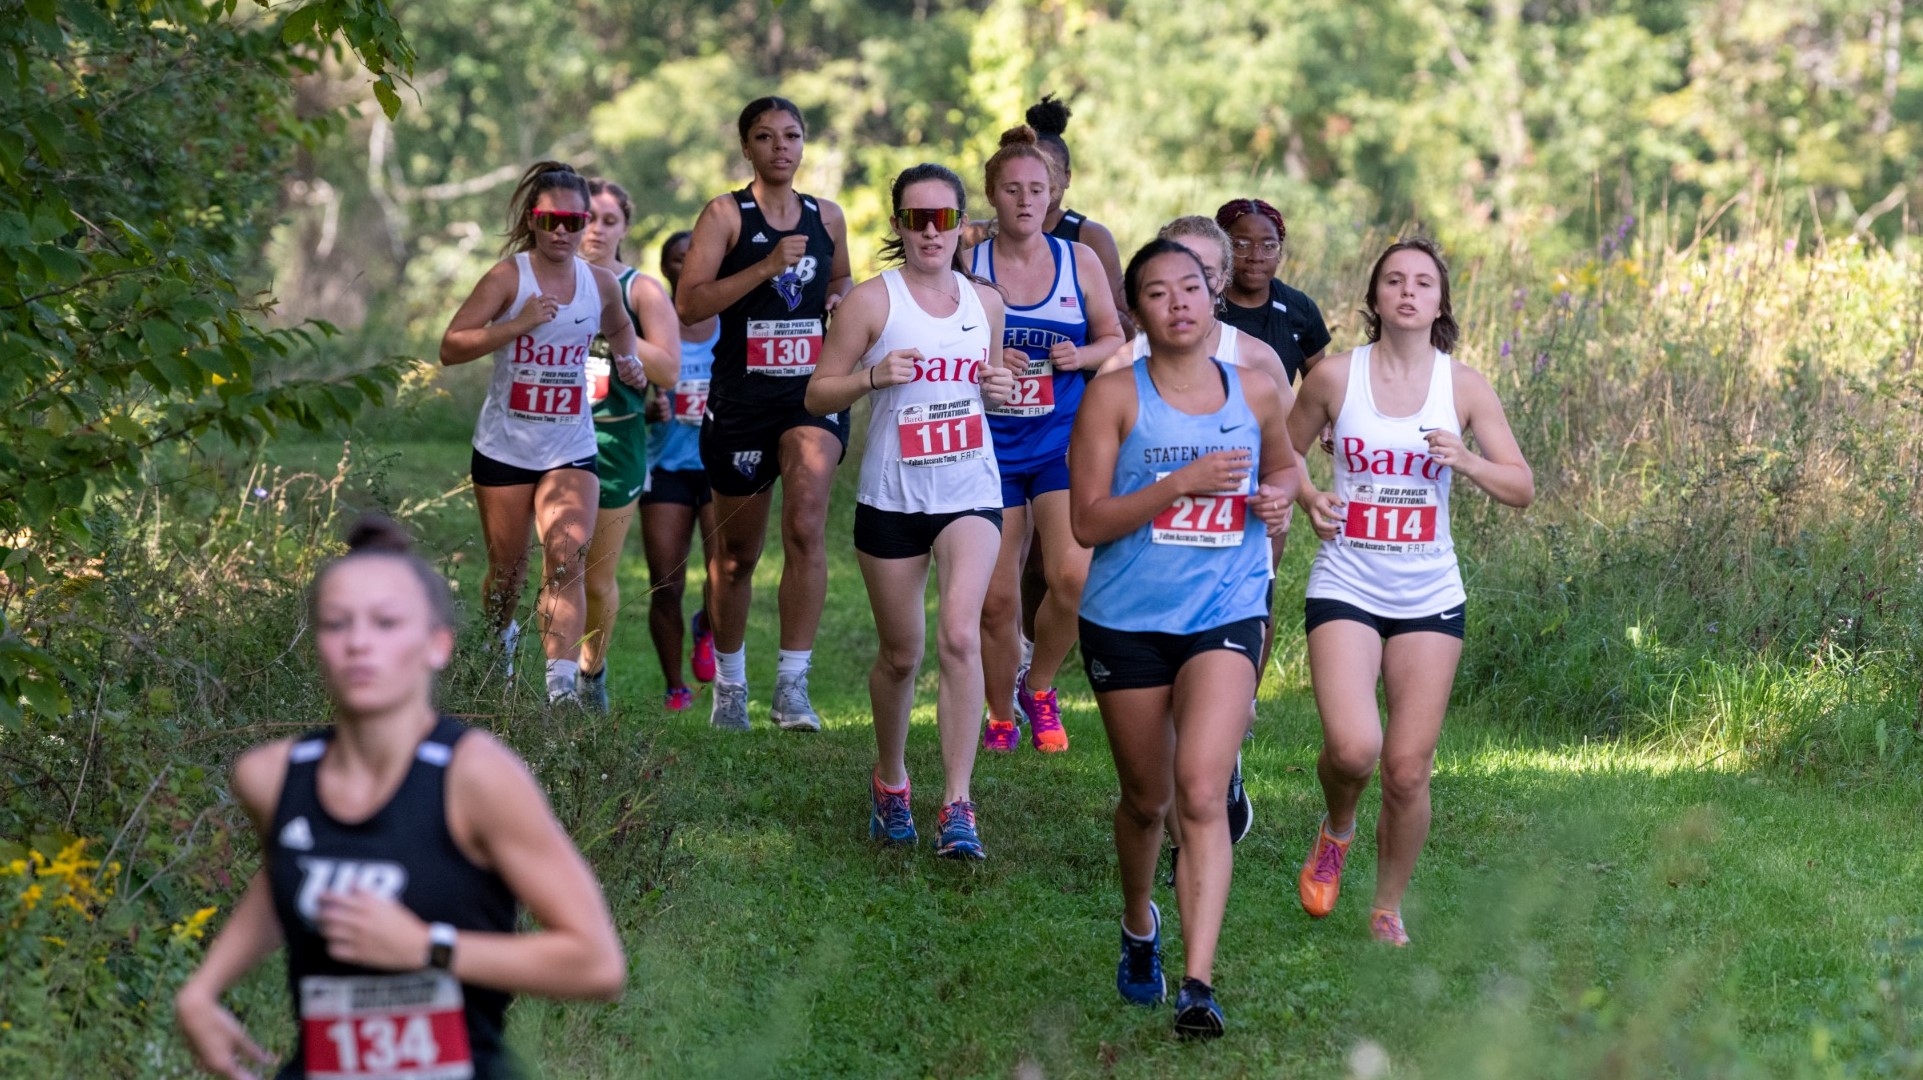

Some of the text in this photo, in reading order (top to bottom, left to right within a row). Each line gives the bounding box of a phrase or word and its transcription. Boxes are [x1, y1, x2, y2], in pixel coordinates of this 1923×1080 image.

[771, 255, 818, 283] B
[774, 328, 813, 336] INVITATIONAL
[512, 333, 592, 366] Bard
[762, 338, 811, 365] 130
[526, 386, 572, 413] 112
[1007, 379, 1040, 405] 82
[928, 408, 971, 420] INVITATIONAL
[929, 400, 971, 411] FRED PAVLICH
[917, 420, 968, 454] 111
[732, 450, 762, 466] UB
[1144, 446, 1199, 464] STATEN
[1378, 496, 1427, 504] INVITATIONAL
[1380, 488, 1428, 496] FRED PAVLICH
[1170, 495, 1233, 530] 274
[1363, 507, 1422, 540] 114
[328, 1016, 441, 1074] 134
